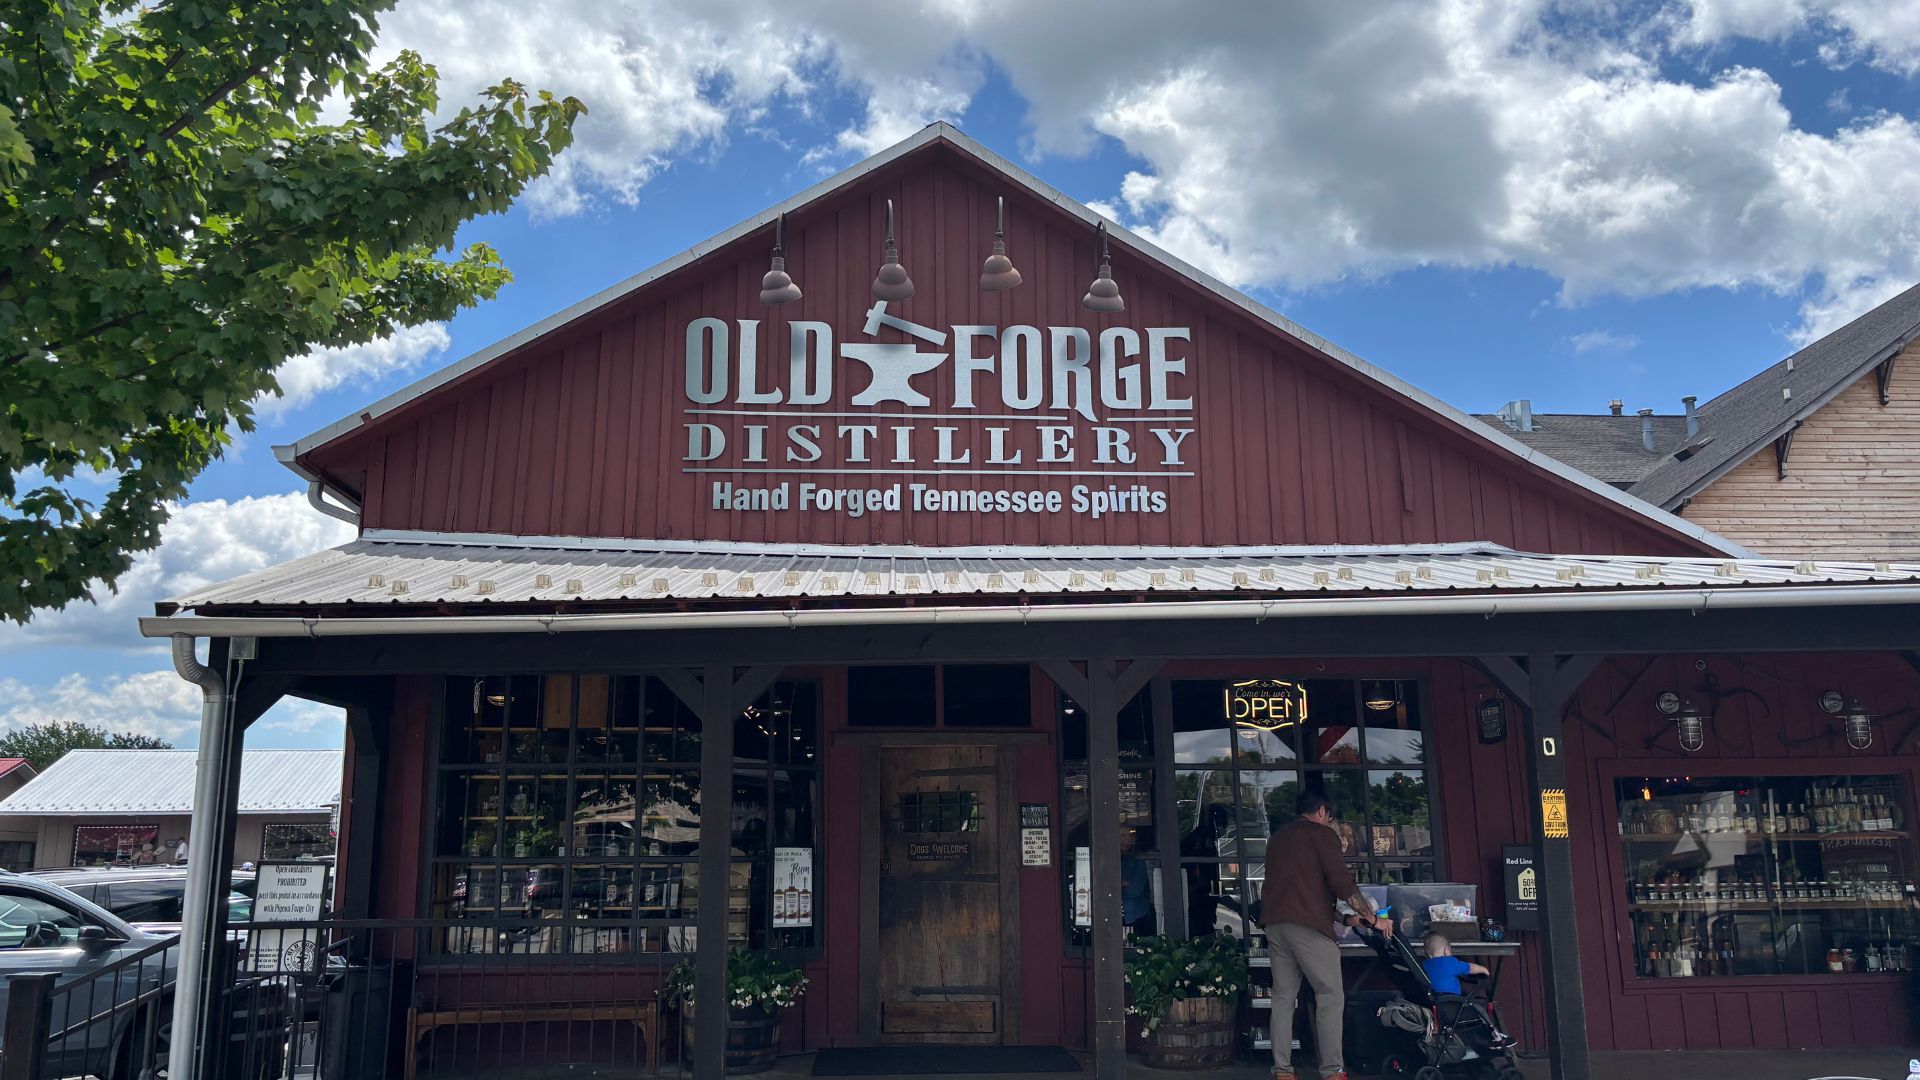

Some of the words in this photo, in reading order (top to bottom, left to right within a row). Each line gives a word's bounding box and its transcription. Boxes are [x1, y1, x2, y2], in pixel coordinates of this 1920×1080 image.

[685, 317, 832, 405] OLD
[950, 325, 1194, 422] FORGE
[683, 423, 1195, 465] DISTILLERY
[712, 481, 789, 511] Hand
[799, 482, 901, 518] Forged
[909, 483, 1062, 513] Tennessee
[1071, 484, 1167, 519] Spirits
[1235, 687, 1256, 698] Come
[1272, 688, 1292, 698] we'r
[1234, 698, 1303, 718] OPEN
[910, 844, 929, 855] DOGS
[932, 844, 968, 854] WELCOME
[1505, 857, 1518, 865] Red
[1519, 857, 1533, 865] Line
[791, 863, 810, 875] Rum
[277, 877, 307, 886] PROHIBITED
